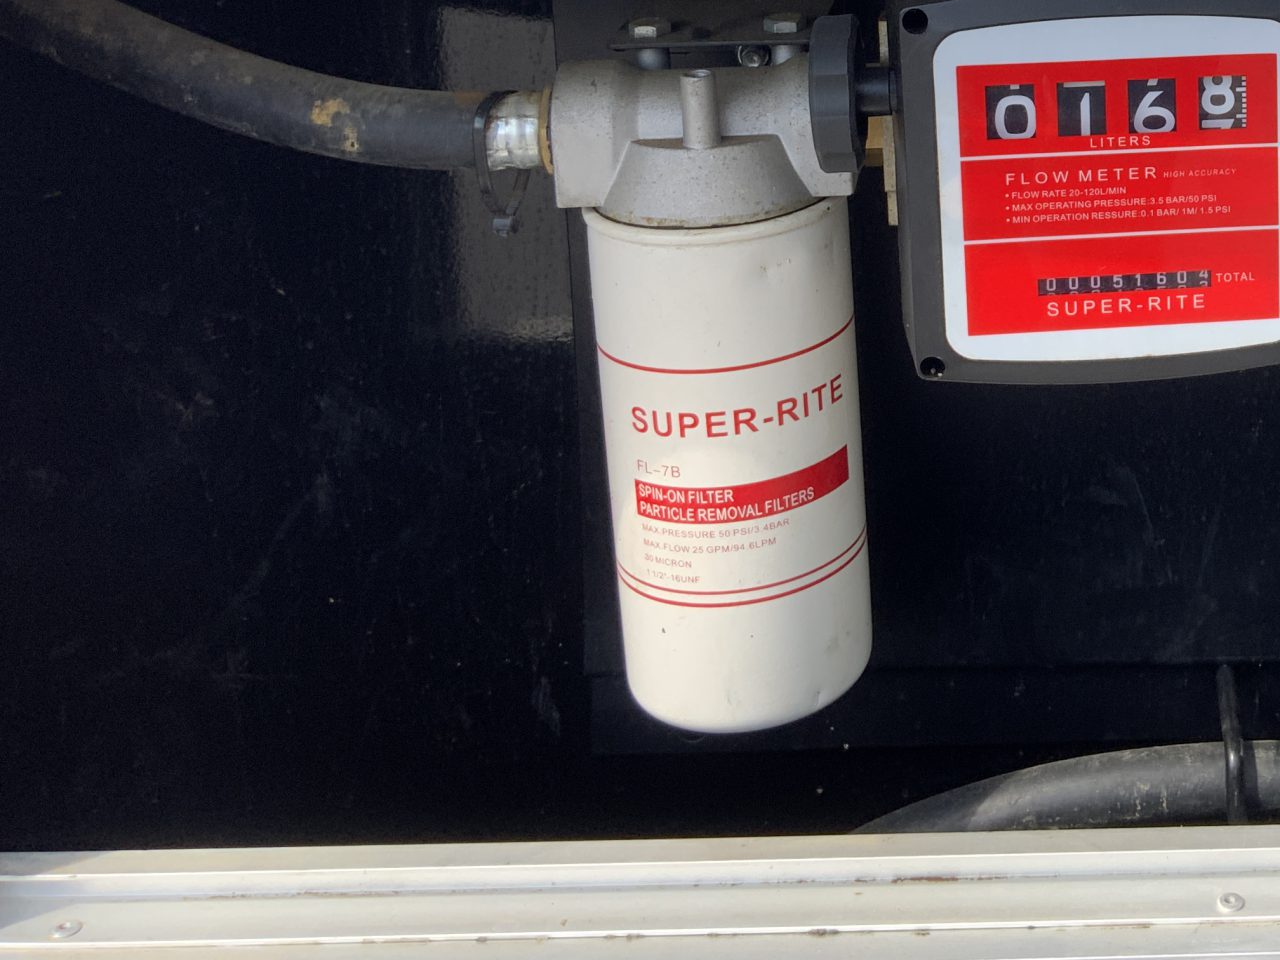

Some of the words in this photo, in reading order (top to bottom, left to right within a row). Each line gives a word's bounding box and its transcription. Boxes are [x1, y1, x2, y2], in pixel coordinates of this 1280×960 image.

[1089, 135, 1151, 149] LITERS
[1005, 170, 1069, 186] FLOW
[1078, 166, 1158, 183] METER
[1163, 169, 1185, 179] HIGH
[1188, 167, 1238, 178] ACCURACY
[1011, 189, 1040, 200] FLOW
[1041, 188, 1067, 199] RATE
[1068, 186, 1127, 198] 20-120L/MIN
[1012, 202, 1037, 213] MAX
[1037, 199, 1093, 211] OPERATING
[1201, 194, 1218, 203] PSI
[1012, 214, 1032, 224] MIN
[1032, 211, 1090, 223] OPERATION
[1215, 204, 1232, 214] PSI
[1216, 271, 1256, 283] TOTAL
[1046, 293, 1206, 317] SUPER-RITE
[630, 373, 844, 439] SUPER-RITE
[637, 459, 681, 478] FL-7B
[638, 483, 686, 503] SPIN-ON
[687, 488, 734, 504] FILTER
[640, 501, 695, 522] PARTICLE
[697, 503, 762, 522] REMOVAL
[764, 486, 816, 514] FILTERS
[718, 530, 731, 538] 50
[692, 545, 704, 554] 25
[655, 555, 693, 568] MICRON
